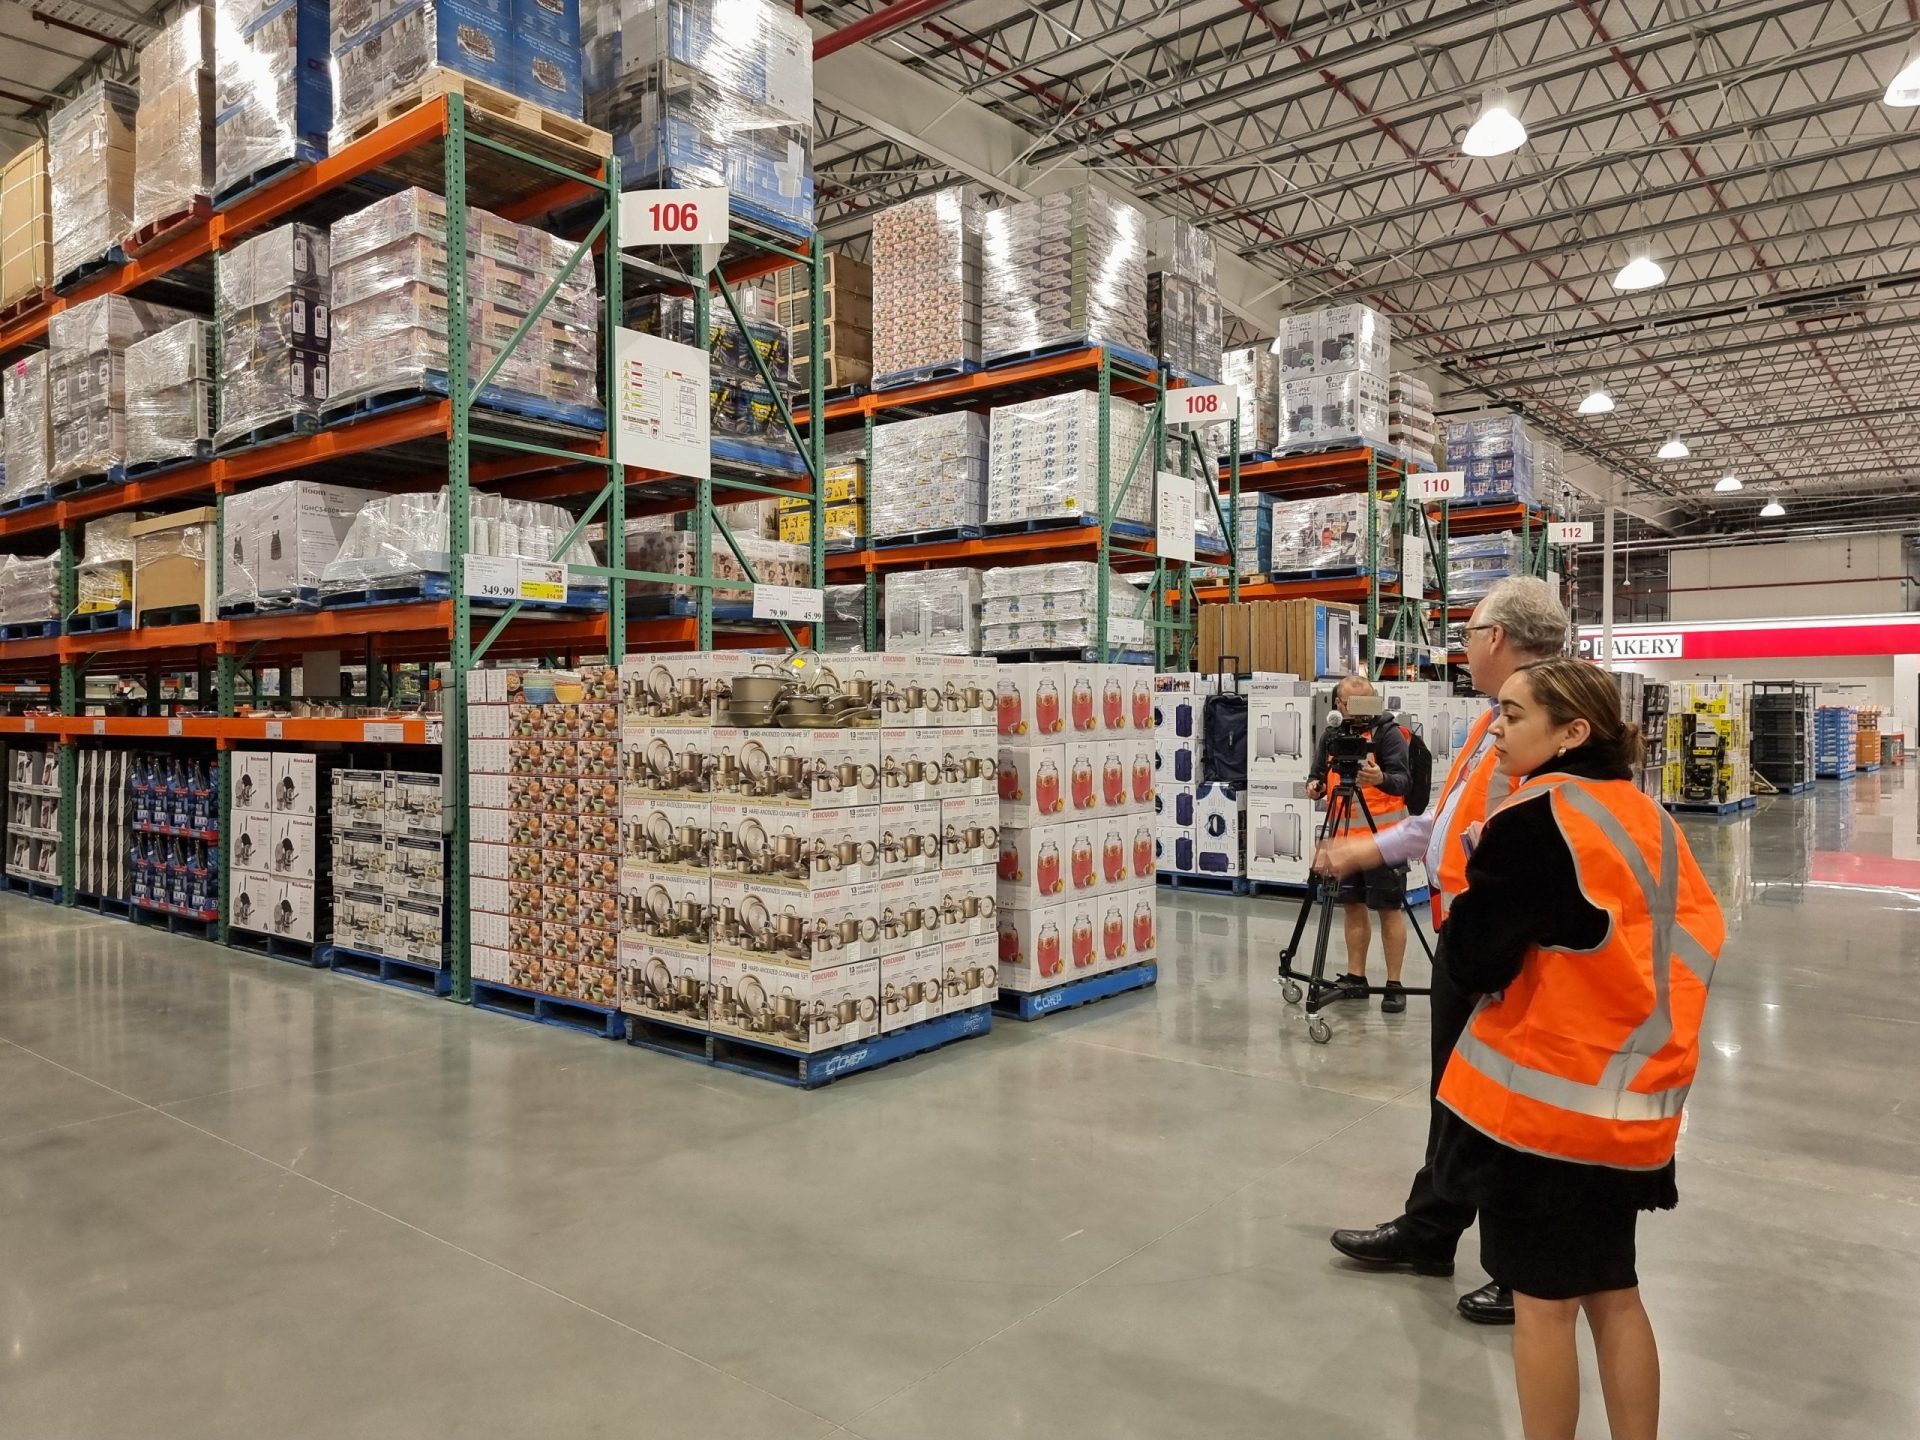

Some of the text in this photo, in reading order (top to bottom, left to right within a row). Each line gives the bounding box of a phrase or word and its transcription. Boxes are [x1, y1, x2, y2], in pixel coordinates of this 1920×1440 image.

[648, 203, 698, 232] 106
[1186, 394, 1218, 414] 108
[1423, 479, 1450, 493] 110
[1561, 527, 1581, 538] 112
[481, 584, 515, 597] 349.99
[769, 608, 788, 618] 79.99
[803, 611, 822, 620] 45.99
